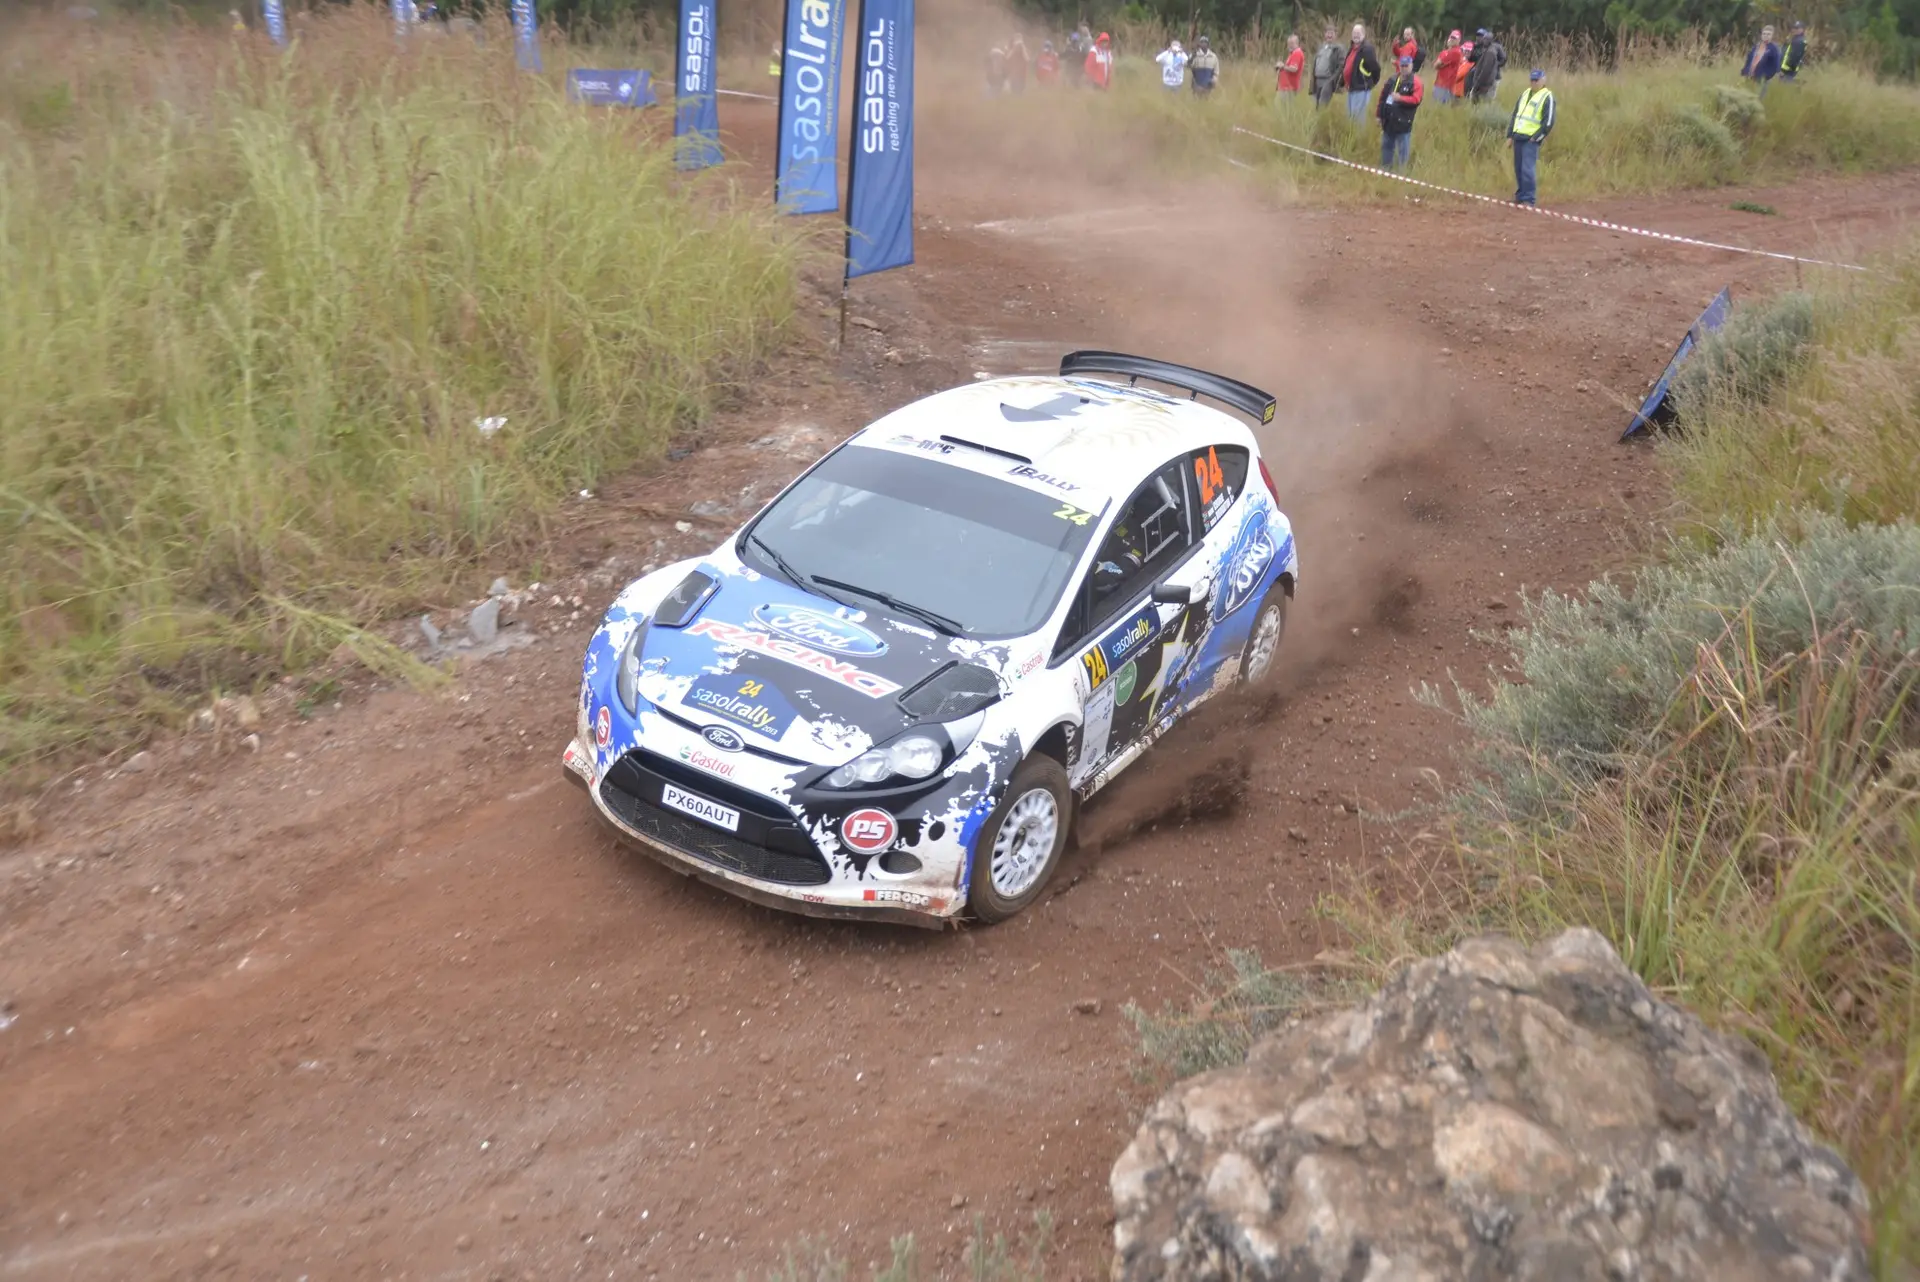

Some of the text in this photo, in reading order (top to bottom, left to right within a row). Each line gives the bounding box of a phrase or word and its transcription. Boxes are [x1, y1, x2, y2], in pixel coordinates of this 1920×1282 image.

[886, 20, 900, 151] reaching new frontiers
[1194, 445, 1223, 505] 24
[1053, 504, 1093, 526] 24
[771, 611, 860, 649] Ford
[1112, 618, 1149, 658] sasolrally
[685, 618, 901, 697] RACING
[1084, 645, 1107, 690] 24
[737, 680, 764, 698] 24
[691, 688, 776, 728] sasolrally
[708, 729, 734, 747] Ford
[690, 751, 735, 777] Castrol
[667, 789, 735, 825] PX60AUT
[850, 819, 887, 840] PS
[802, 893, 825, 903] TOW
